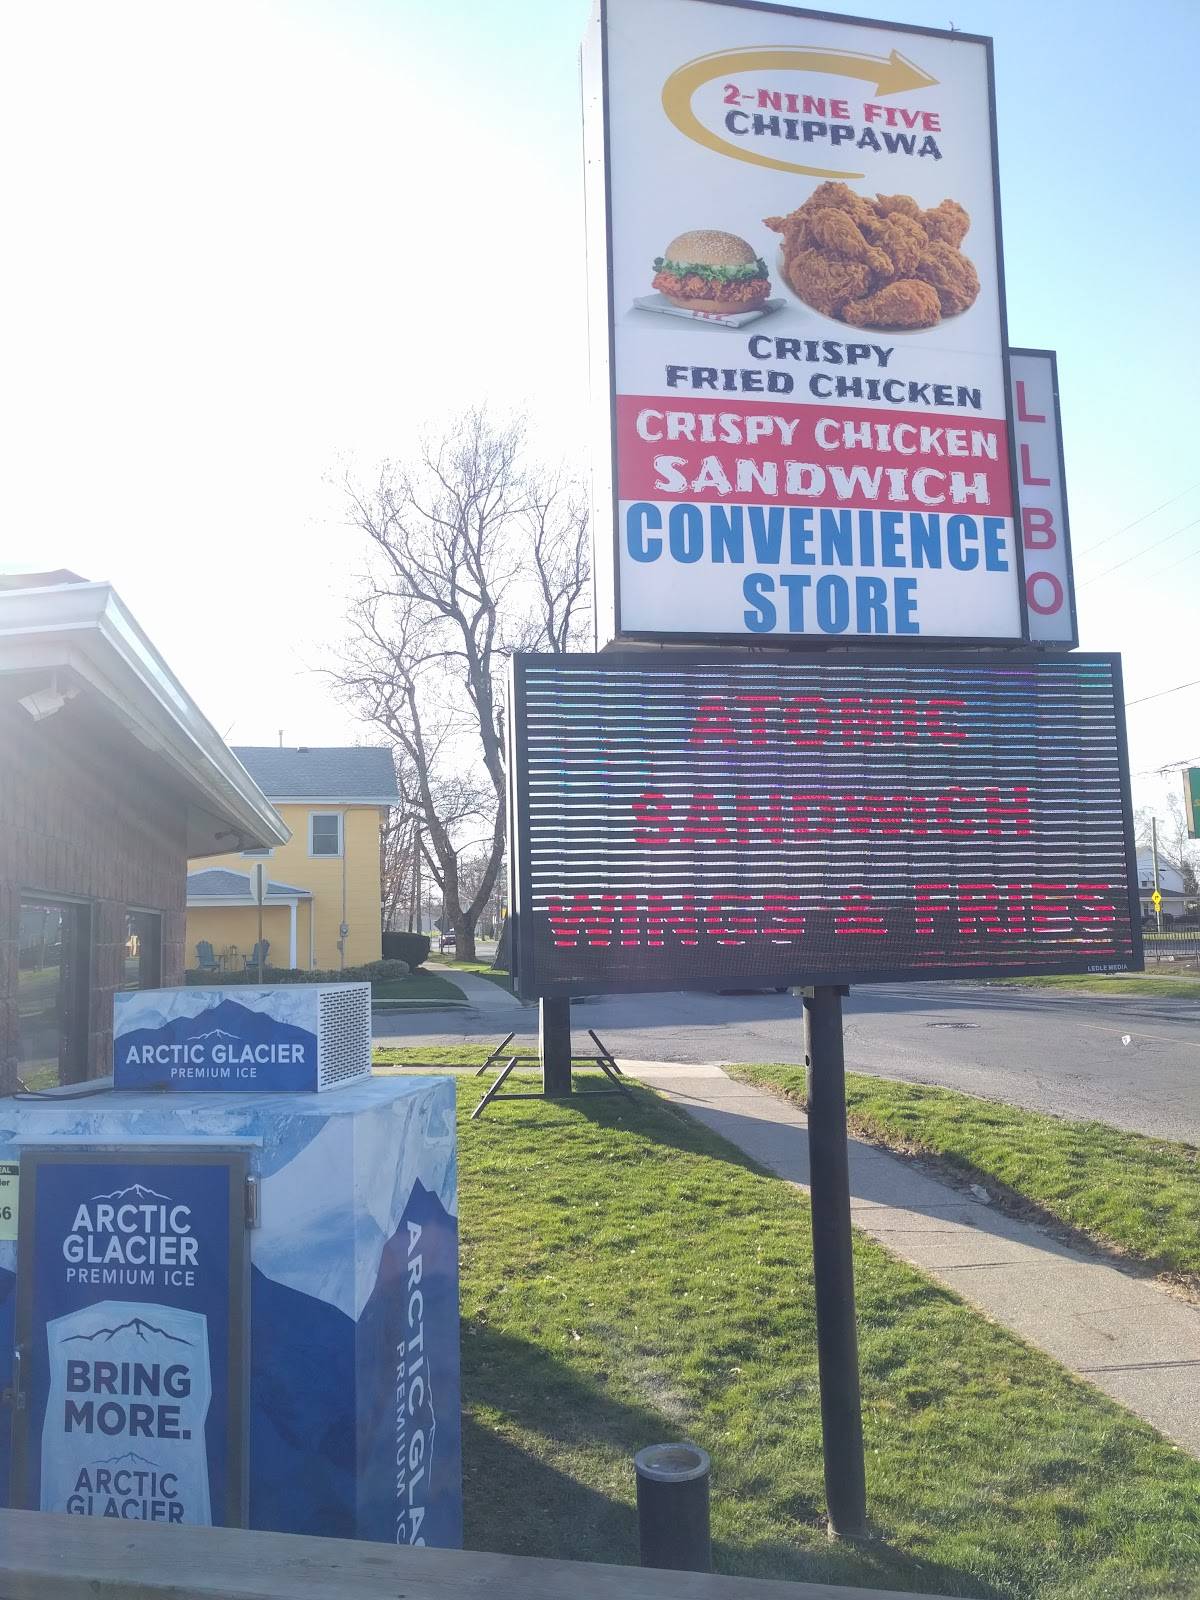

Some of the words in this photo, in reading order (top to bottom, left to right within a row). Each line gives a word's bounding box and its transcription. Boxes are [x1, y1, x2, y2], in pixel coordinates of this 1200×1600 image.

[723, 83, 850, 120] 2-NINE
[863, 103, 942, 133] FIVE
[724, 110, 943, 161] CHIPPAWA
[748, 335, 895, 368] CRISPY
[666, 364, 794, 394] FRIED
[808, 372, 982, 410] CHICKEN
[635, 408, 800, 446] CRISPY
[814, 417, 999, 461] CHICKEN
[653, 454, 992, 506] SANDWICH
[626, 502, 1010, 573] CONVENIENCE
[742, 573, 921, 635] STORE
[691, 694, 967, 748] ATOMIC
[632, 786, 1032, 846] SANDWICH
[547, 890, 804, 950] WINGS
[914, 881, 1117, 950] FRIES
[126, 1044, 205, 1065] ARCTIC
[213, 1044, 305, 1065] GLACIER
[170, 1068, 231, 1079] PREMIUM
[236, 1068, 258, 1079] ICE
[71, 1204, 192, 1235] ARCTIC
[62, 1236, 199, 1267] GLACIER
[66, 1268, 155, 1286] PREMIUM
[164, 1269, 195, 1287] ICE
[407, 1220, 424, 1416] ARCTIC
[66, 1359, 191, 1399] BRING
[64, 1401, 192, 1440] MORE.
[396, 1342, 406, 1498] PREMIUM
[74, 1467, 178, 1499] ARCTIC
